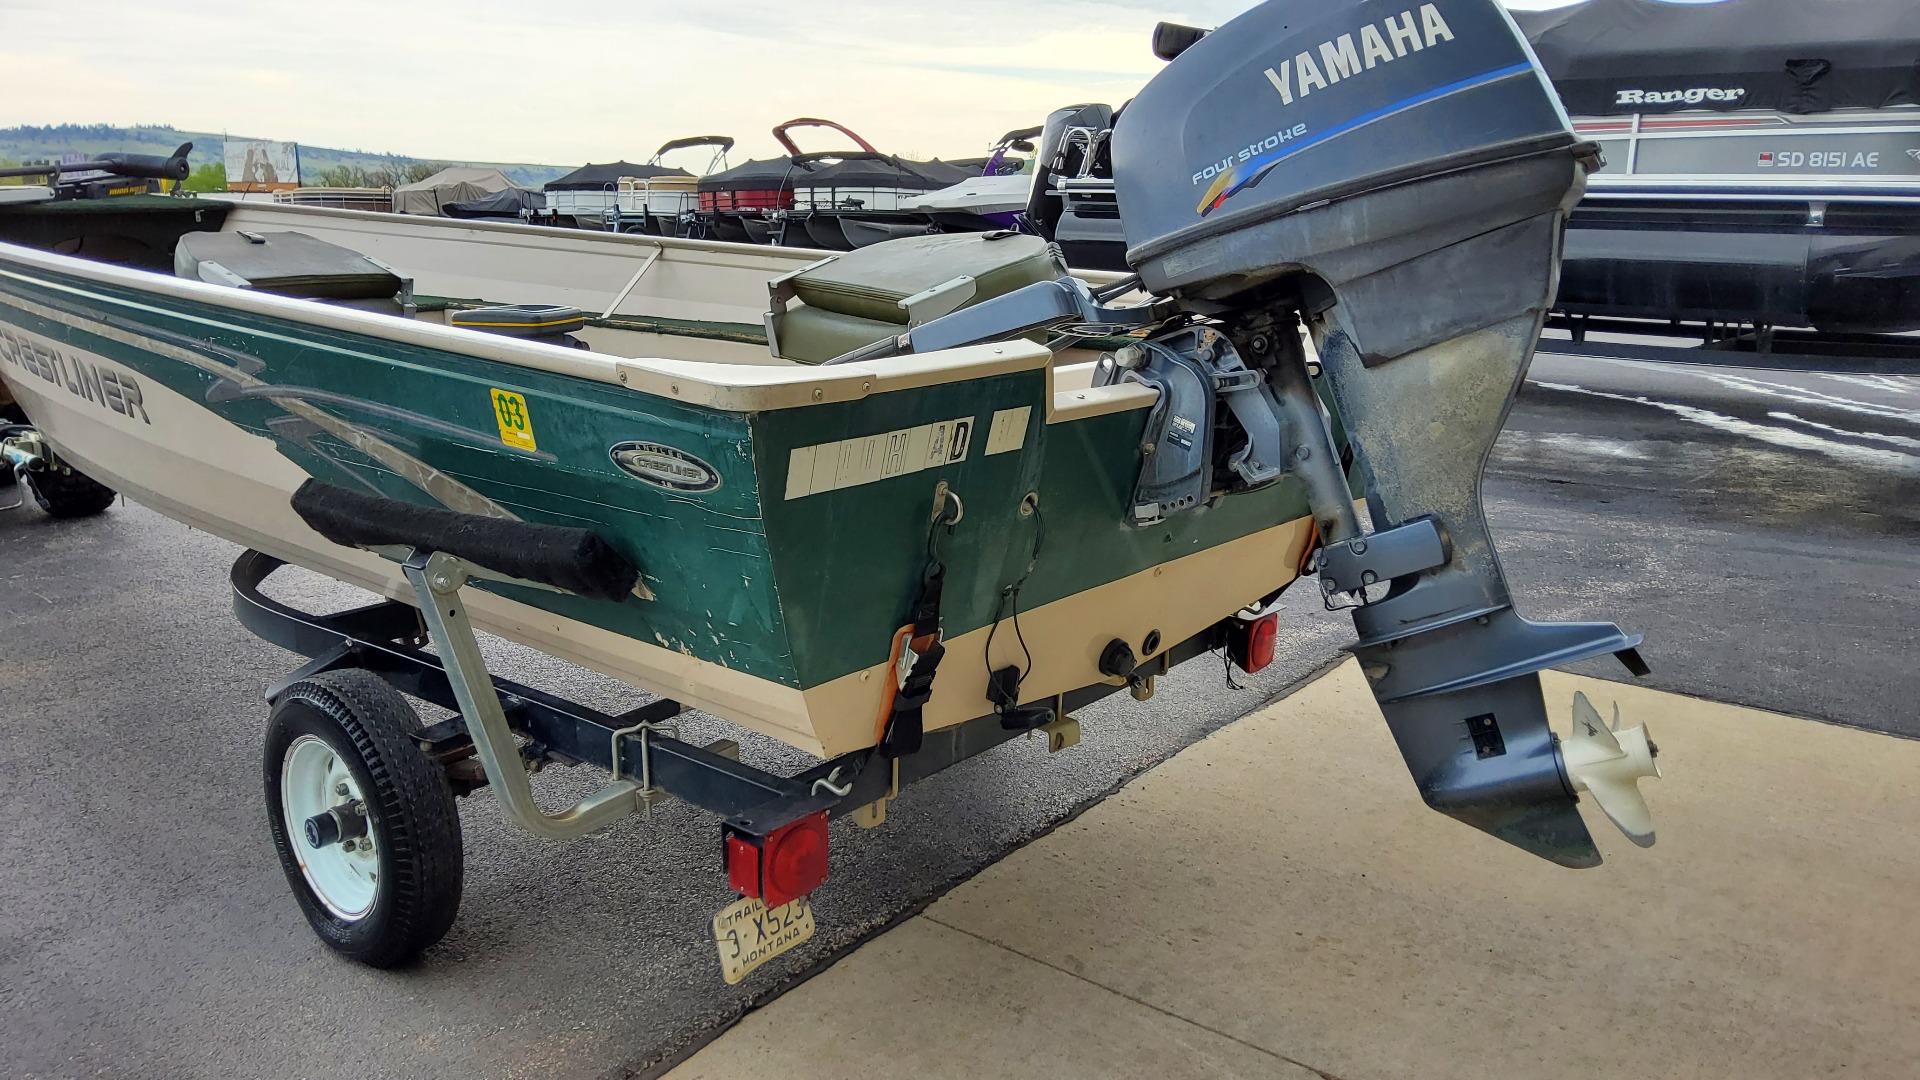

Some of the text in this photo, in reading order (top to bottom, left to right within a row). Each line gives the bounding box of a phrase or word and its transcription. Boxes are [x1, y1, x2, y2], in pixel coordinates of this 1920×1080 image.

[1264, 2, 1455, 106] YAMAHA
[1616, 88, 1745, 104] Ranger
[1777, 151, 1880, 168] SD 8151 AE
[497, 393, 525, 431] 03
[635, 444, 683, 460] ANGLER
[636, 458, 702, 480] CRESTLINER
[726, 901, 763, 926] TRAIL
[741, 927, 801, 968] MONTANA
